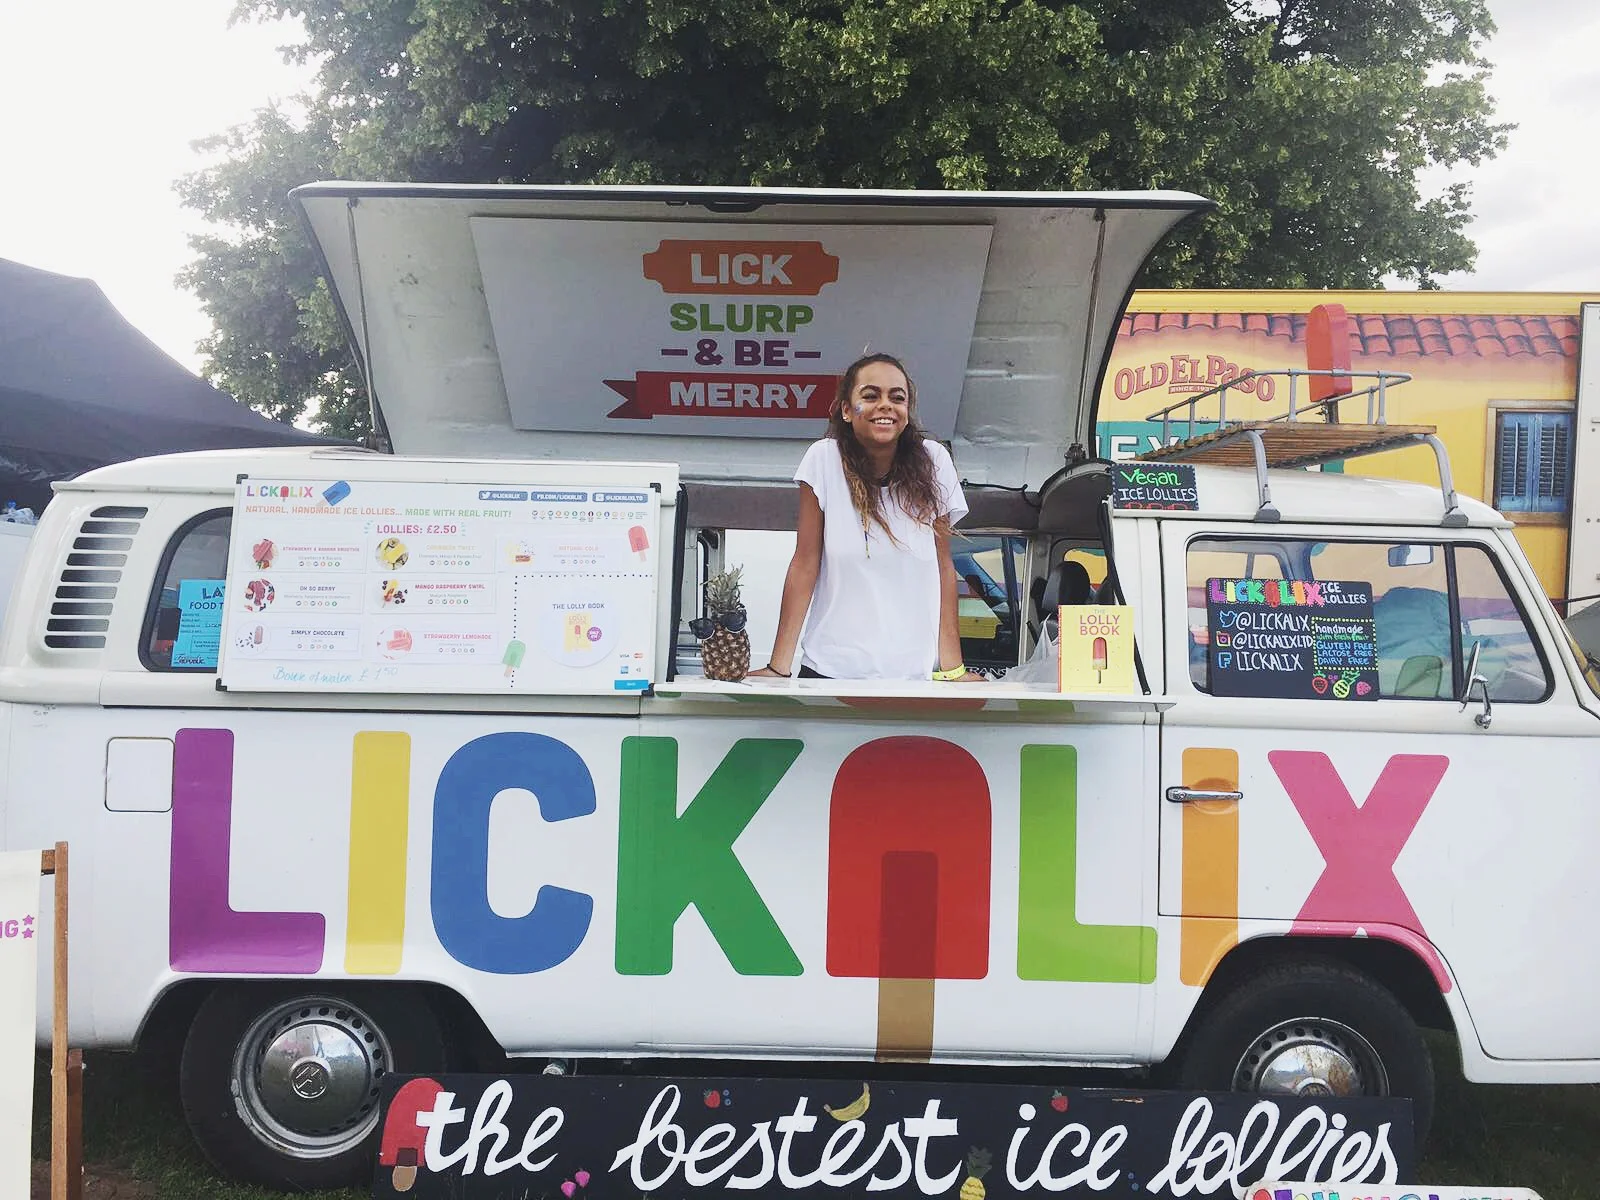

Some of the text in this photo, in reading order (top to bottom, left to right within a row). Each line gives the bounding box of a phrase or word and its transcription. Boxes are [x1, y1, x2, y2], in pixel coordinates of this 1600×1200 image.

[690, 253, 793, 286] LICK
[669, 302, 814, 333] SLURP
[694, 338, 790, 367] & BE
[1114, 362, 1169, 400] OLD
[669, 381, 817, 409] MERRY
[1119, 469, 1183, 487] Vegan
[1118, 487, 1198, 502] ICE LOLLIES
[245, 505, 289, 514] NATURAL,
[291, 505, 341, 515] HANDMADE
[343, 507, 358, 515] ICE
[405, 508, 430, 516] MADE
[432, 509, 456, 517] WITH
[458, 509, 480, 517] REAL
[482, 509, 512, 518] FRUIT!
[376, 524, 457, 534] LOLLIES: £2.50
[1320, 582, 1342, 594] ICE
[189, 601, 217, 610] FOOD
[1324, 594, 1367, 604] LOLLIES
[1079, 614, 1121, 625] LOLLY
[1236, 611, 1310, 632] @LICKALIX
[1079, 625, 1120, 636] BOOK
[1315, 622, 1364, 635] handmade
[1232, 632, 1314, 650] @LICKALIXLTD
[1316, 640, 1374, 650] GLUTEN FREE
[1236, 650, 1304, 671] LICKALIX
[1317, 656, 1370, 665] DAIRY FREE
[415, 1079, 1399, 1198] the bestest ice lollies
